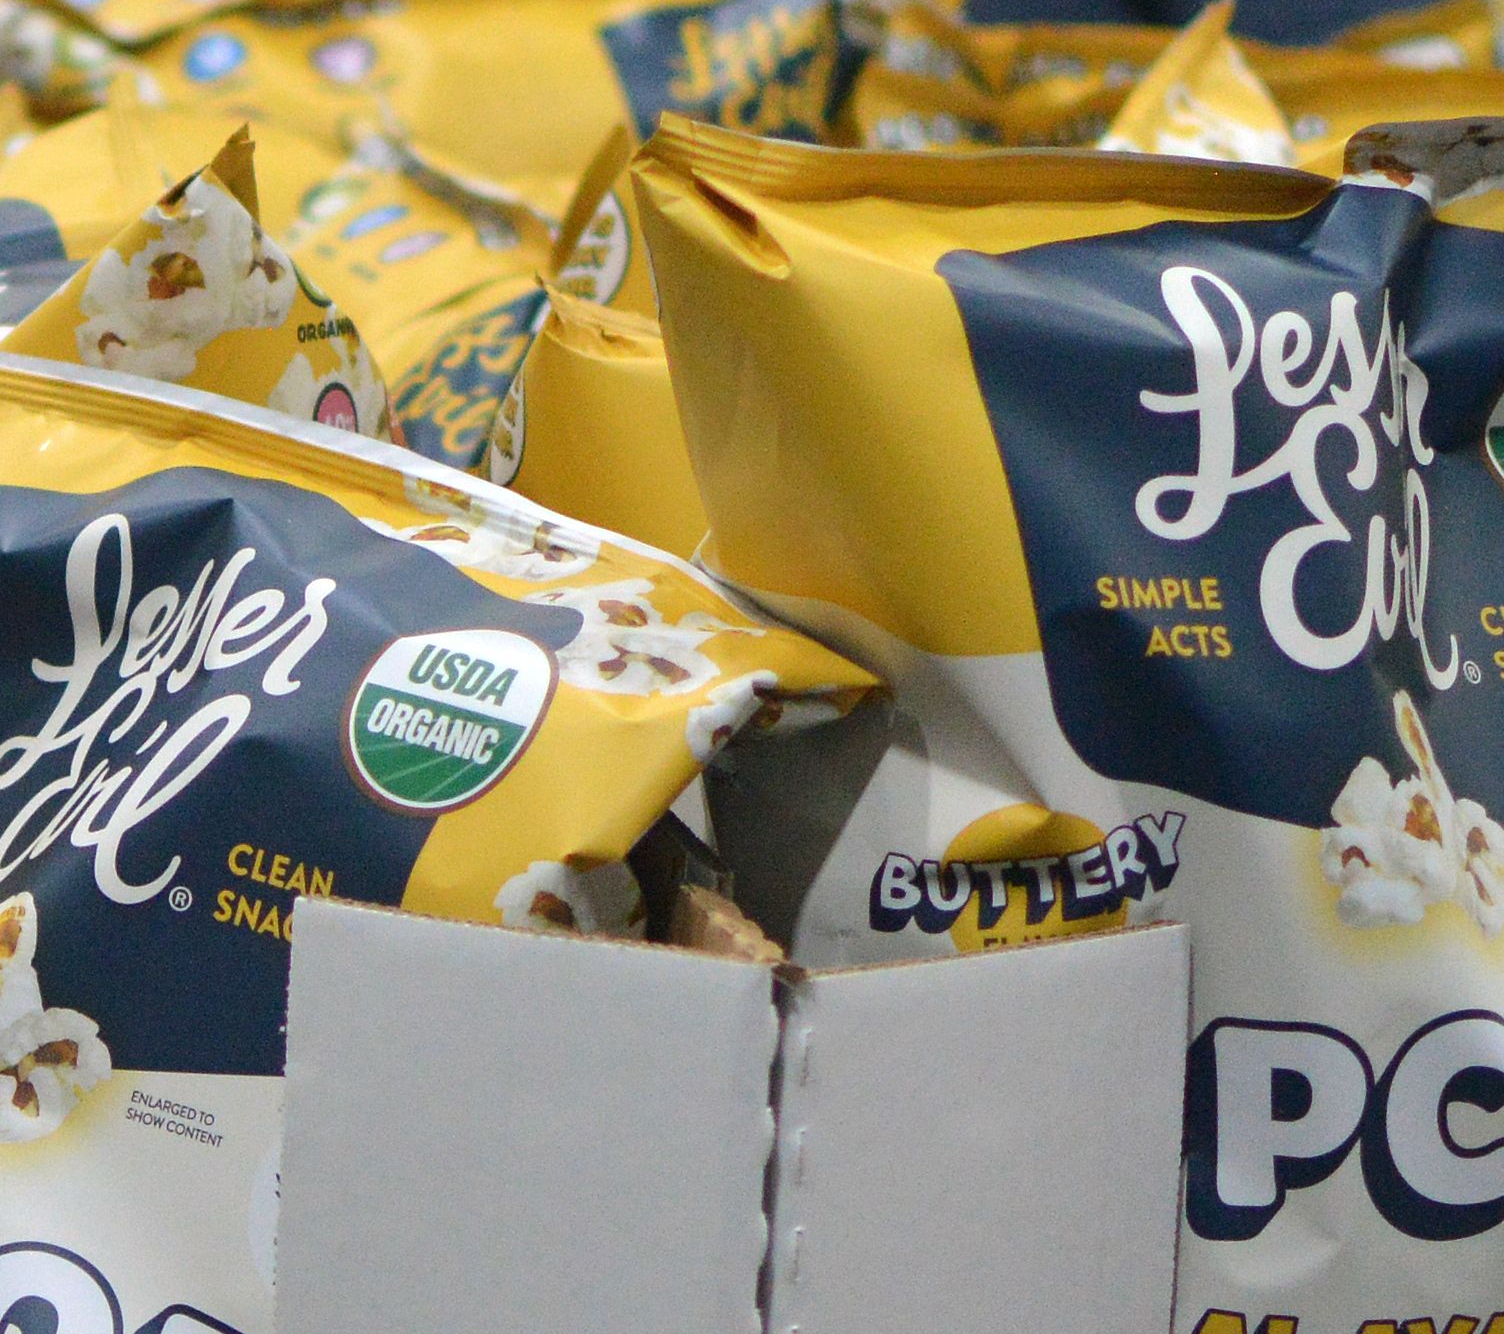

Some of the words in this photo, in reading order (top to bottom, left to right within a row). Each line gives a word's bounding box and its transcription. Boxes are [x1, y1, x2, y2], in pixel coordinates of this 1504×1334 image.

[297, 316, 360, 343] ORGAN
[1096, 574, 1223, 612] SIMPLE
[1145, 622, 1235, 660] ACTS
[407, 642, 519, 709] USDA
[366, 696, 501, 767] ORGANIC
[227, 842, 335, 898] CLEAN
[868, 810, 1188, 935] BUTTERY
[124, 1107, 165, 1130] SHOW
[165, 1119, 224, 1149] CONTENT
[130, 1090, 197, 1122] ENLARGED
[194, 1108, 216, 1127] TO
